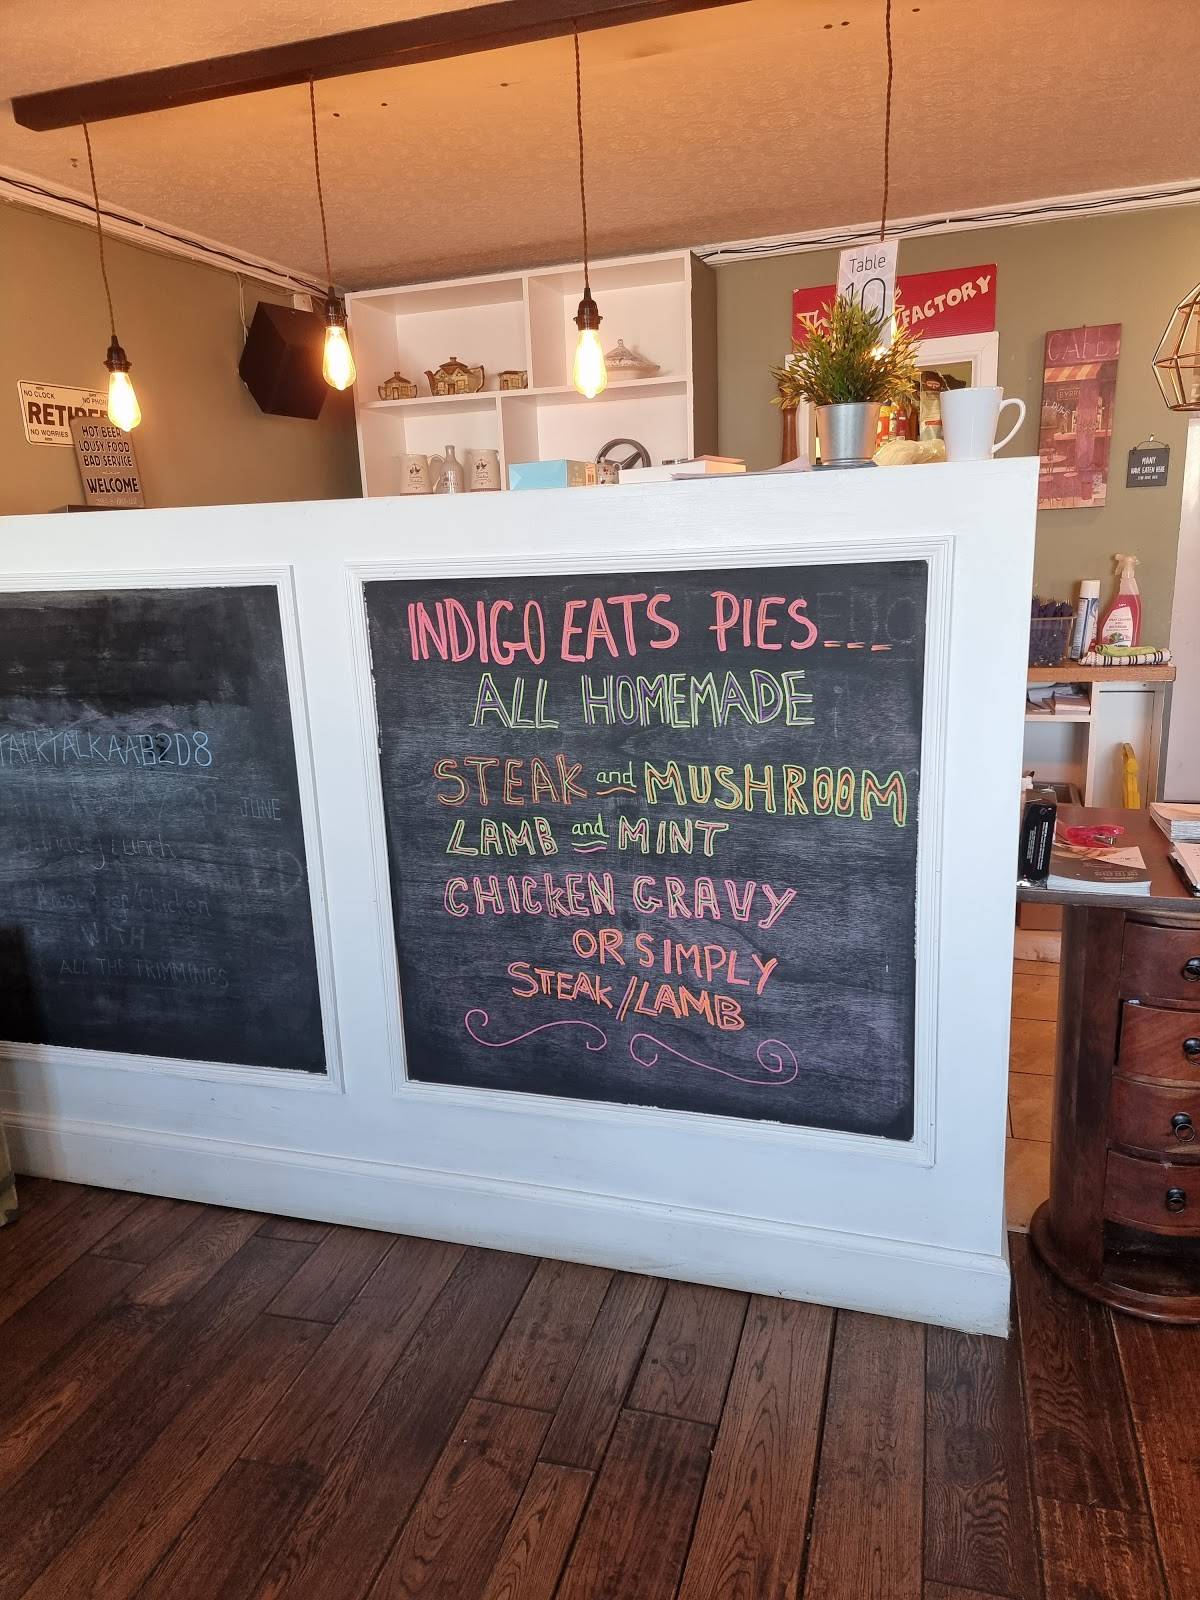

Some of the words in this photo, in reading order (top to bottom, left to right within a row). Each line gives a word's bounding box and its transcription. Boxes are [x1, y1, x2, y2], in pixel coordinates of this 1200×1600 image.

[849, 254, 887, 274] Table
[901, 275, 992, 328] FACTORY
[23, 389, 33, 397] NO
[33, 391, 56, 400] CLOCK
[30, 428, 40, 436] NO
[40, 429, 69, 438] WORRIES
[81, 425, 100, 438] HOT
[101, 426, 122, 438] BEER
[78, 440, 104, 452] LOUSY
[107, 441, 131, 453] FOOD
[83, 455, 101, 467] BAD
[103, 455, 133, 467] SERVICE
[86, 478, 140, 494] WELCOME
[407, 597, 546, 666] INDIGO
[560, 592, 681, 663] EATS
[468, 672, 560, 729] ALL
[581, 668, 816, 729] HOMEMADE
[433, 753, 589, 807] STEAK
[596, 760, 638, 788] and
[644, 760, 908, 828] MUSHROOM
[445, 816, 559, 857] LAMB
[571, 812, 610, 838] and
[618, 815, 730, 858] MINT
[443, 872, 616, 918] CHICKEN
[632, 875, 798, 930] GRAVY
[59, 958, 90, 977] ALL
[95, 957, 129, 977] THE
[572, 928, 626, 966] OR
[636, 932, 779, 996] SIMPLY
